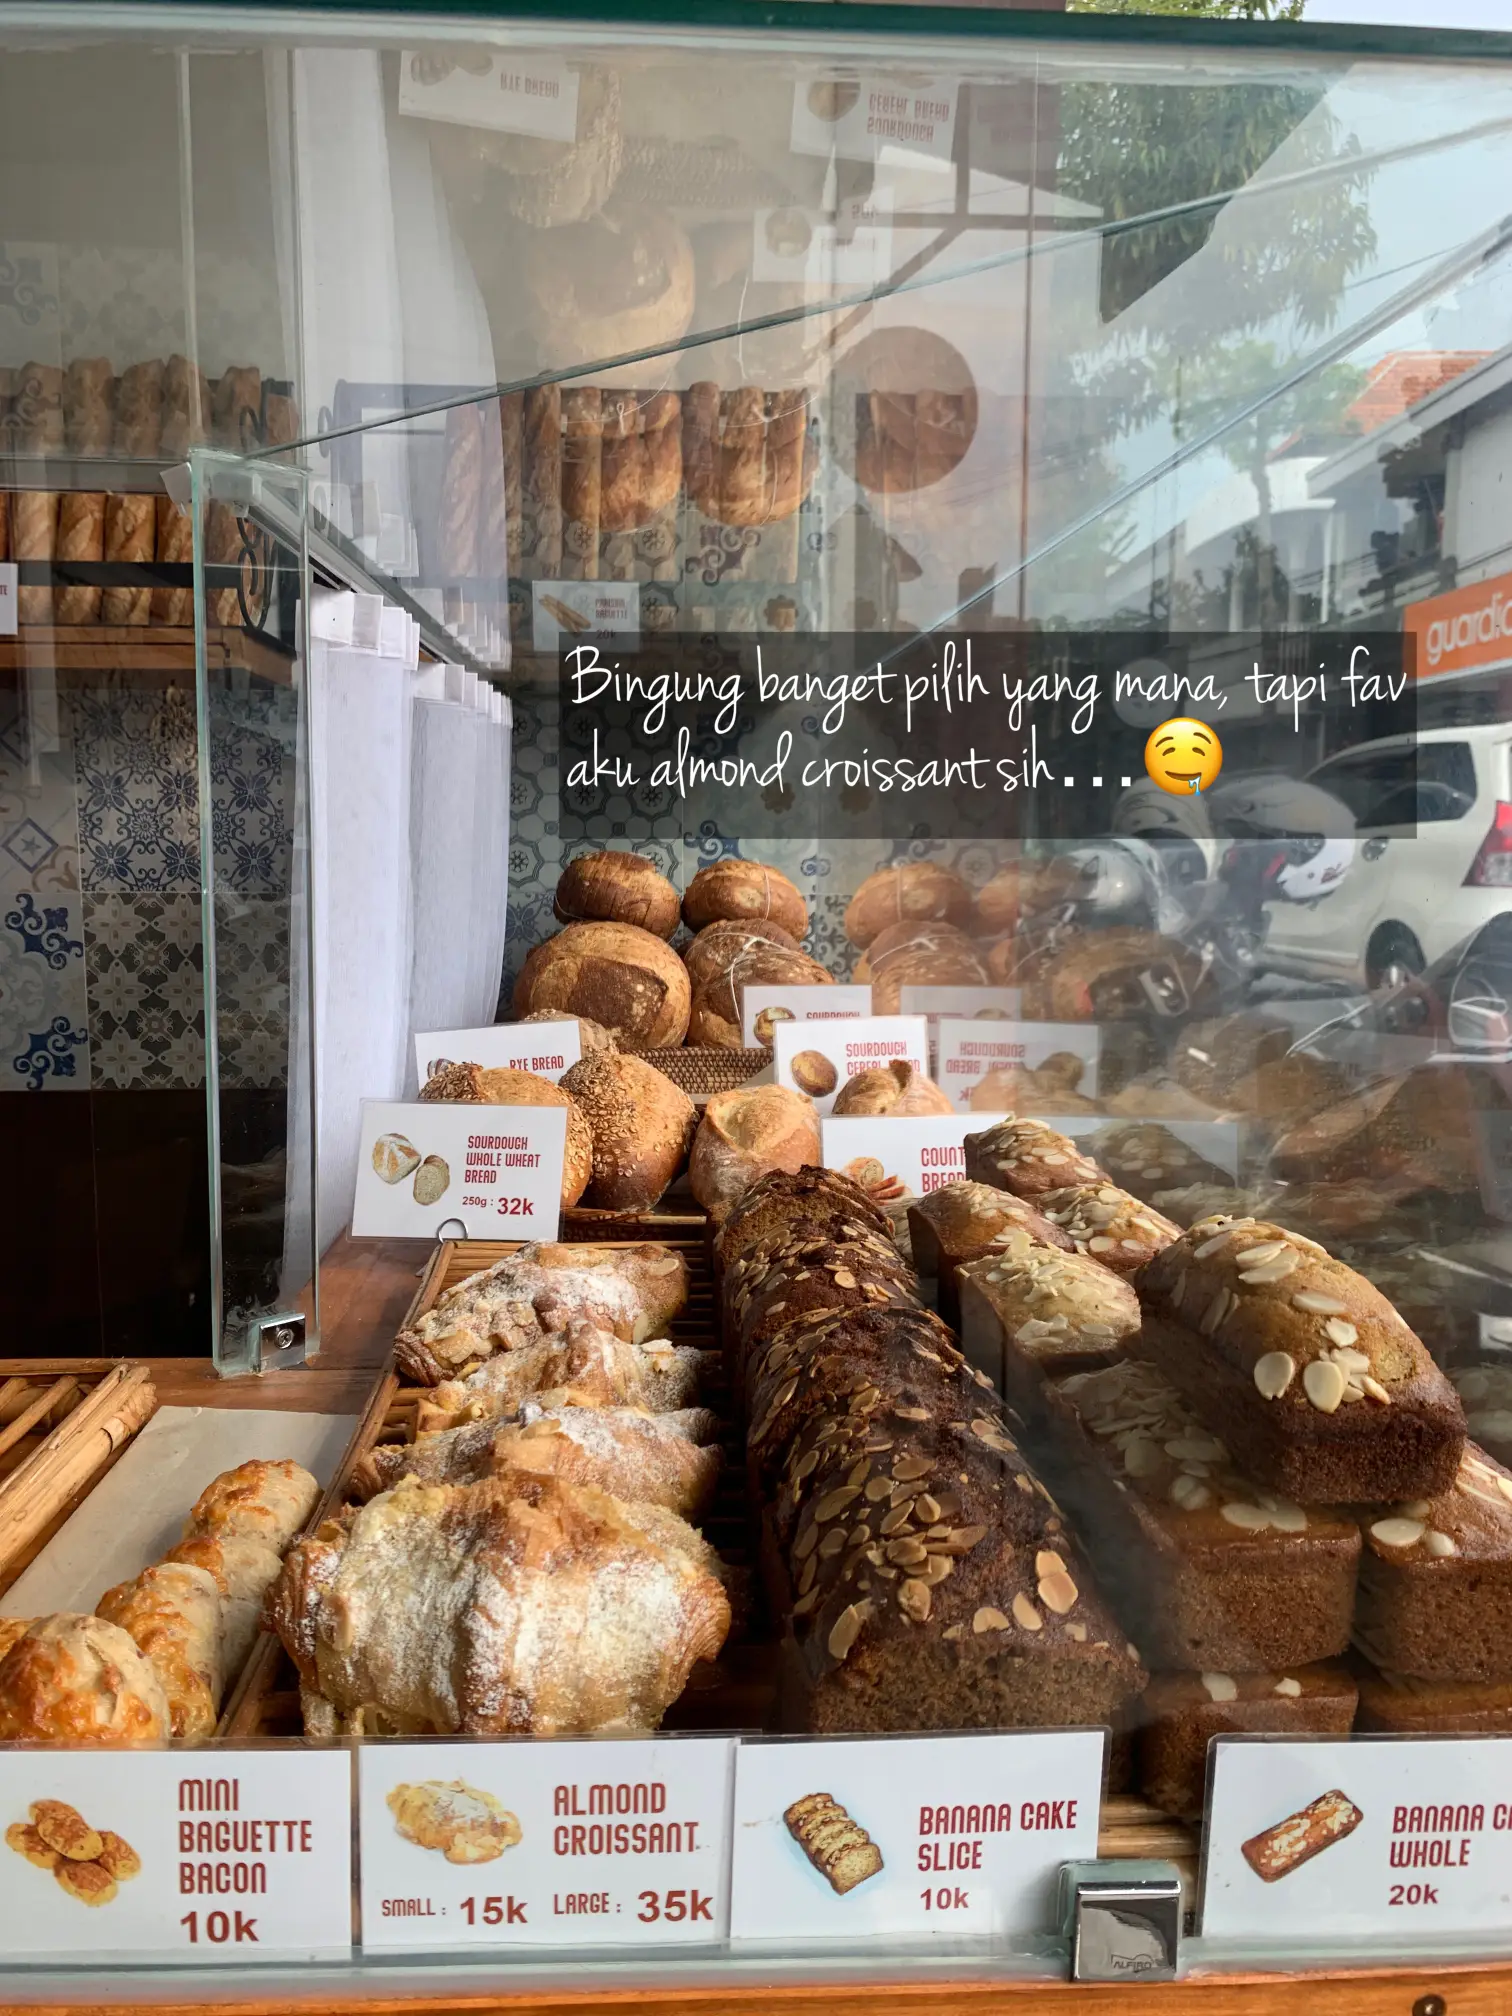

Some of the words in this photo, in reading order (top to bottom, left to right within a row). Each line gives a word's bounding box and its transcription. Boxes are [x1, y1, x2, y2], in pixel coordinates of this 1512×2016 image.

[532, 1056, 564, 1071] BREAD
[846, 1041, 908, 1058] SOURDOUGH
[468, 1136, 528, 1150] SOURDOUGH
[466, 1152, 502, 1167] WHOLE
[505, 1154, 541, 1168] WHEAT
[464, 1170, 497, 1184] BREAD
[462, 1196, 487, 1208] 250g
[497, 1197, 534, 1215] 32k
[179, 1778, 239, 1812] MINI
[553, 1782, 666, 1816] ALMOND
[919, 1803, 1012, 1836] BANANA
[1020, 1800, 1078, 1831] CAKE
[1392, 1803, 1485, 1834] BANANA
[179, 1820, 313, 1853] BAGUETTE
[553, 1821, 700, 1856] CROISSANT
[917, 1840, 983, 1872] SLICE
[1389, 1838, 1472, 1868] WHOLE
[179, 1862, 267, 1894] BACON
[382, 1897, 436, 1917] SMALL
[460, 1896, 528, 1925] 15k
[553, 1892, 610, 1914] LARGE
[637, 1890, 714, 1922] 35k
[920, 1887, 970, 1911] 10k
[1388, 1883, 1439, 1906] 20k
[180, 1910, 260, 1944] 10k
